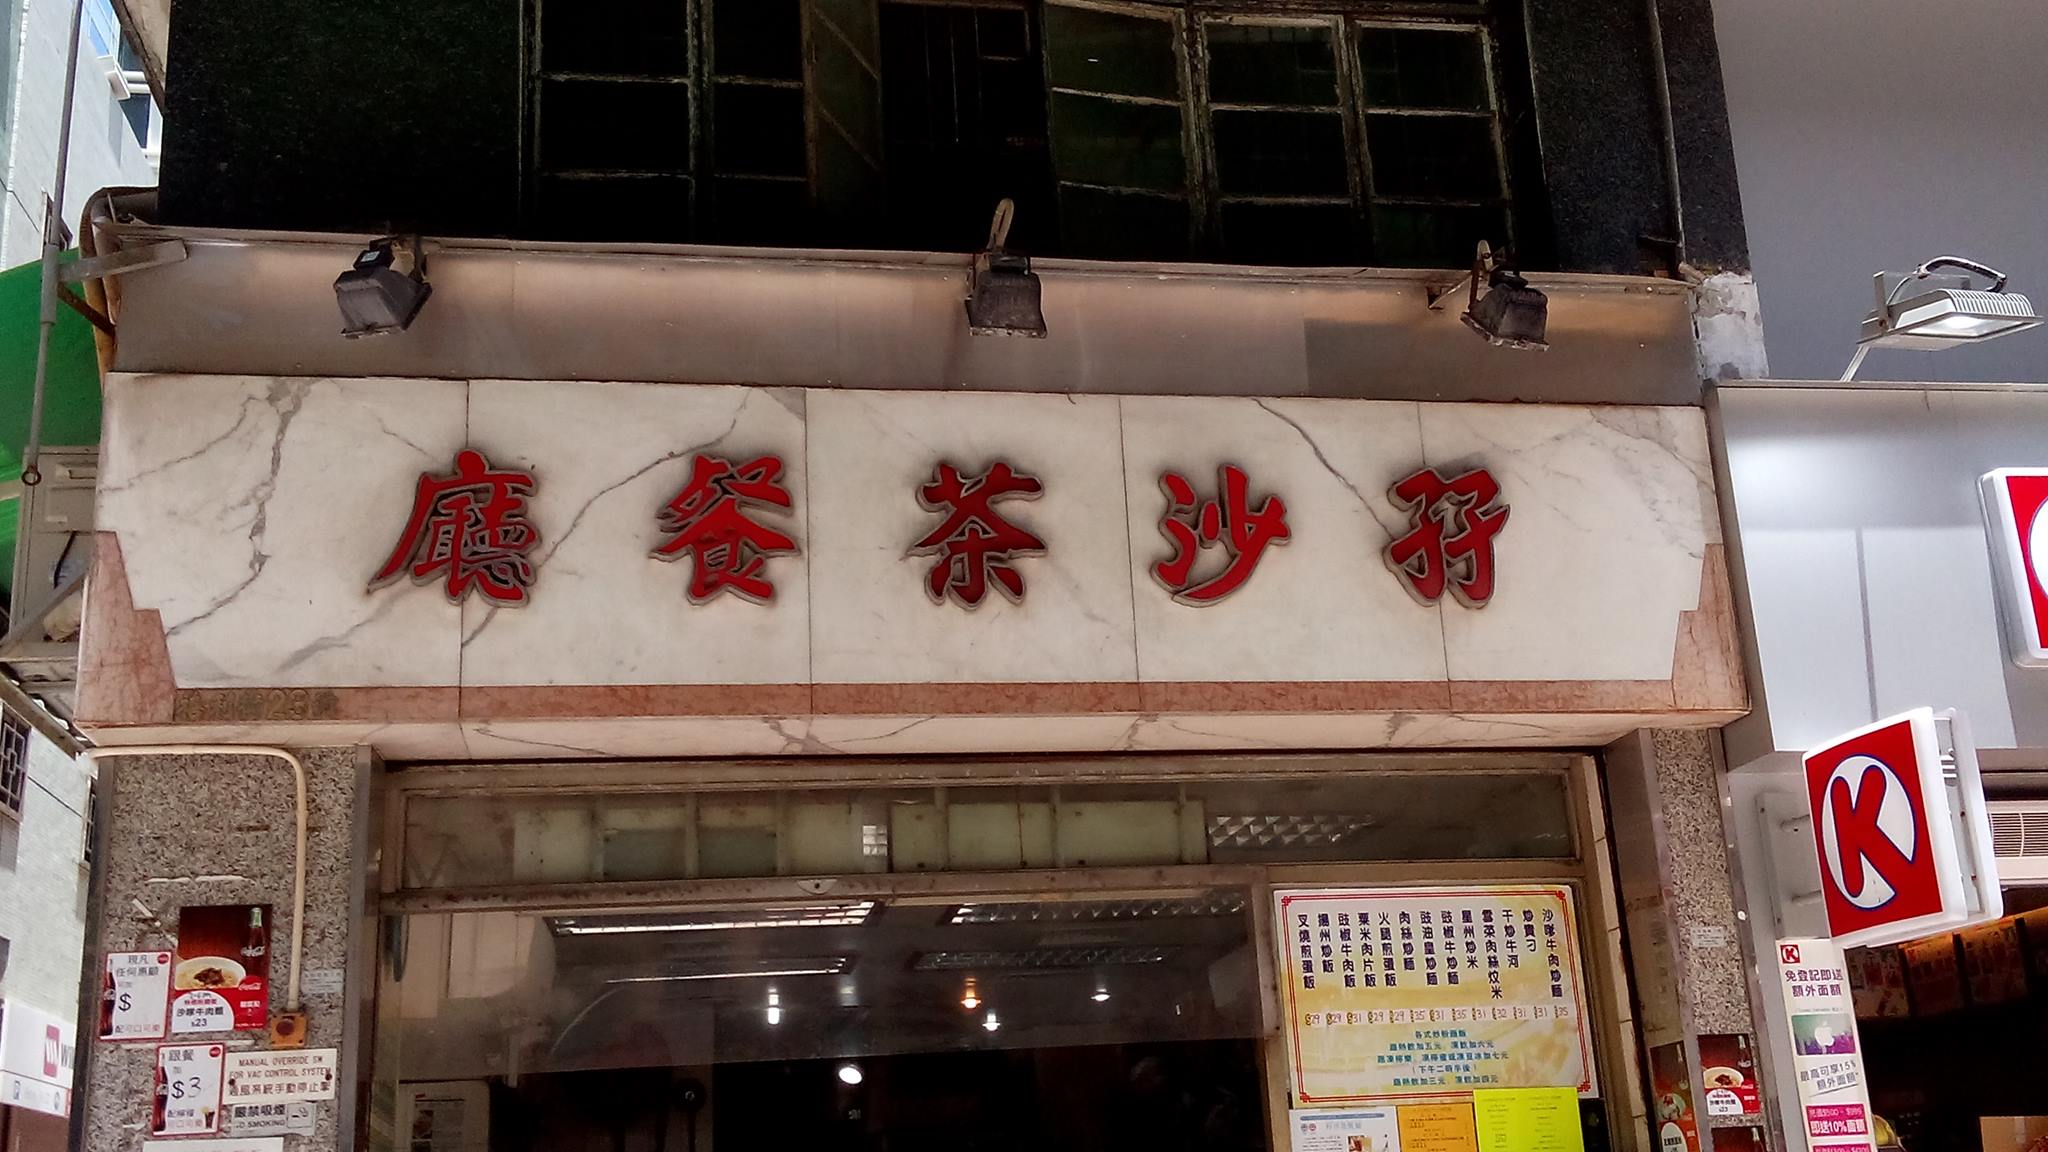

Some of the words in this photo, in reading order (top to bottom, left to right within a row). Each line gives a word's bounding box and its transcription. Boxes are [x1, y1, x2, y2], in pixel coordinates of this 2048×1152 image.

[1785, 969, 1843, 982] 免登記即送
[1792, 984, 1842, 997] 額外面額
[239, 1058, 268, 1066] MANUAL
[272, 1056, 309, 1065] OVERRIDE
[265, 1069, 298, 1077] CONTROL
[247, 1120, 286, 1128] SMOKING
